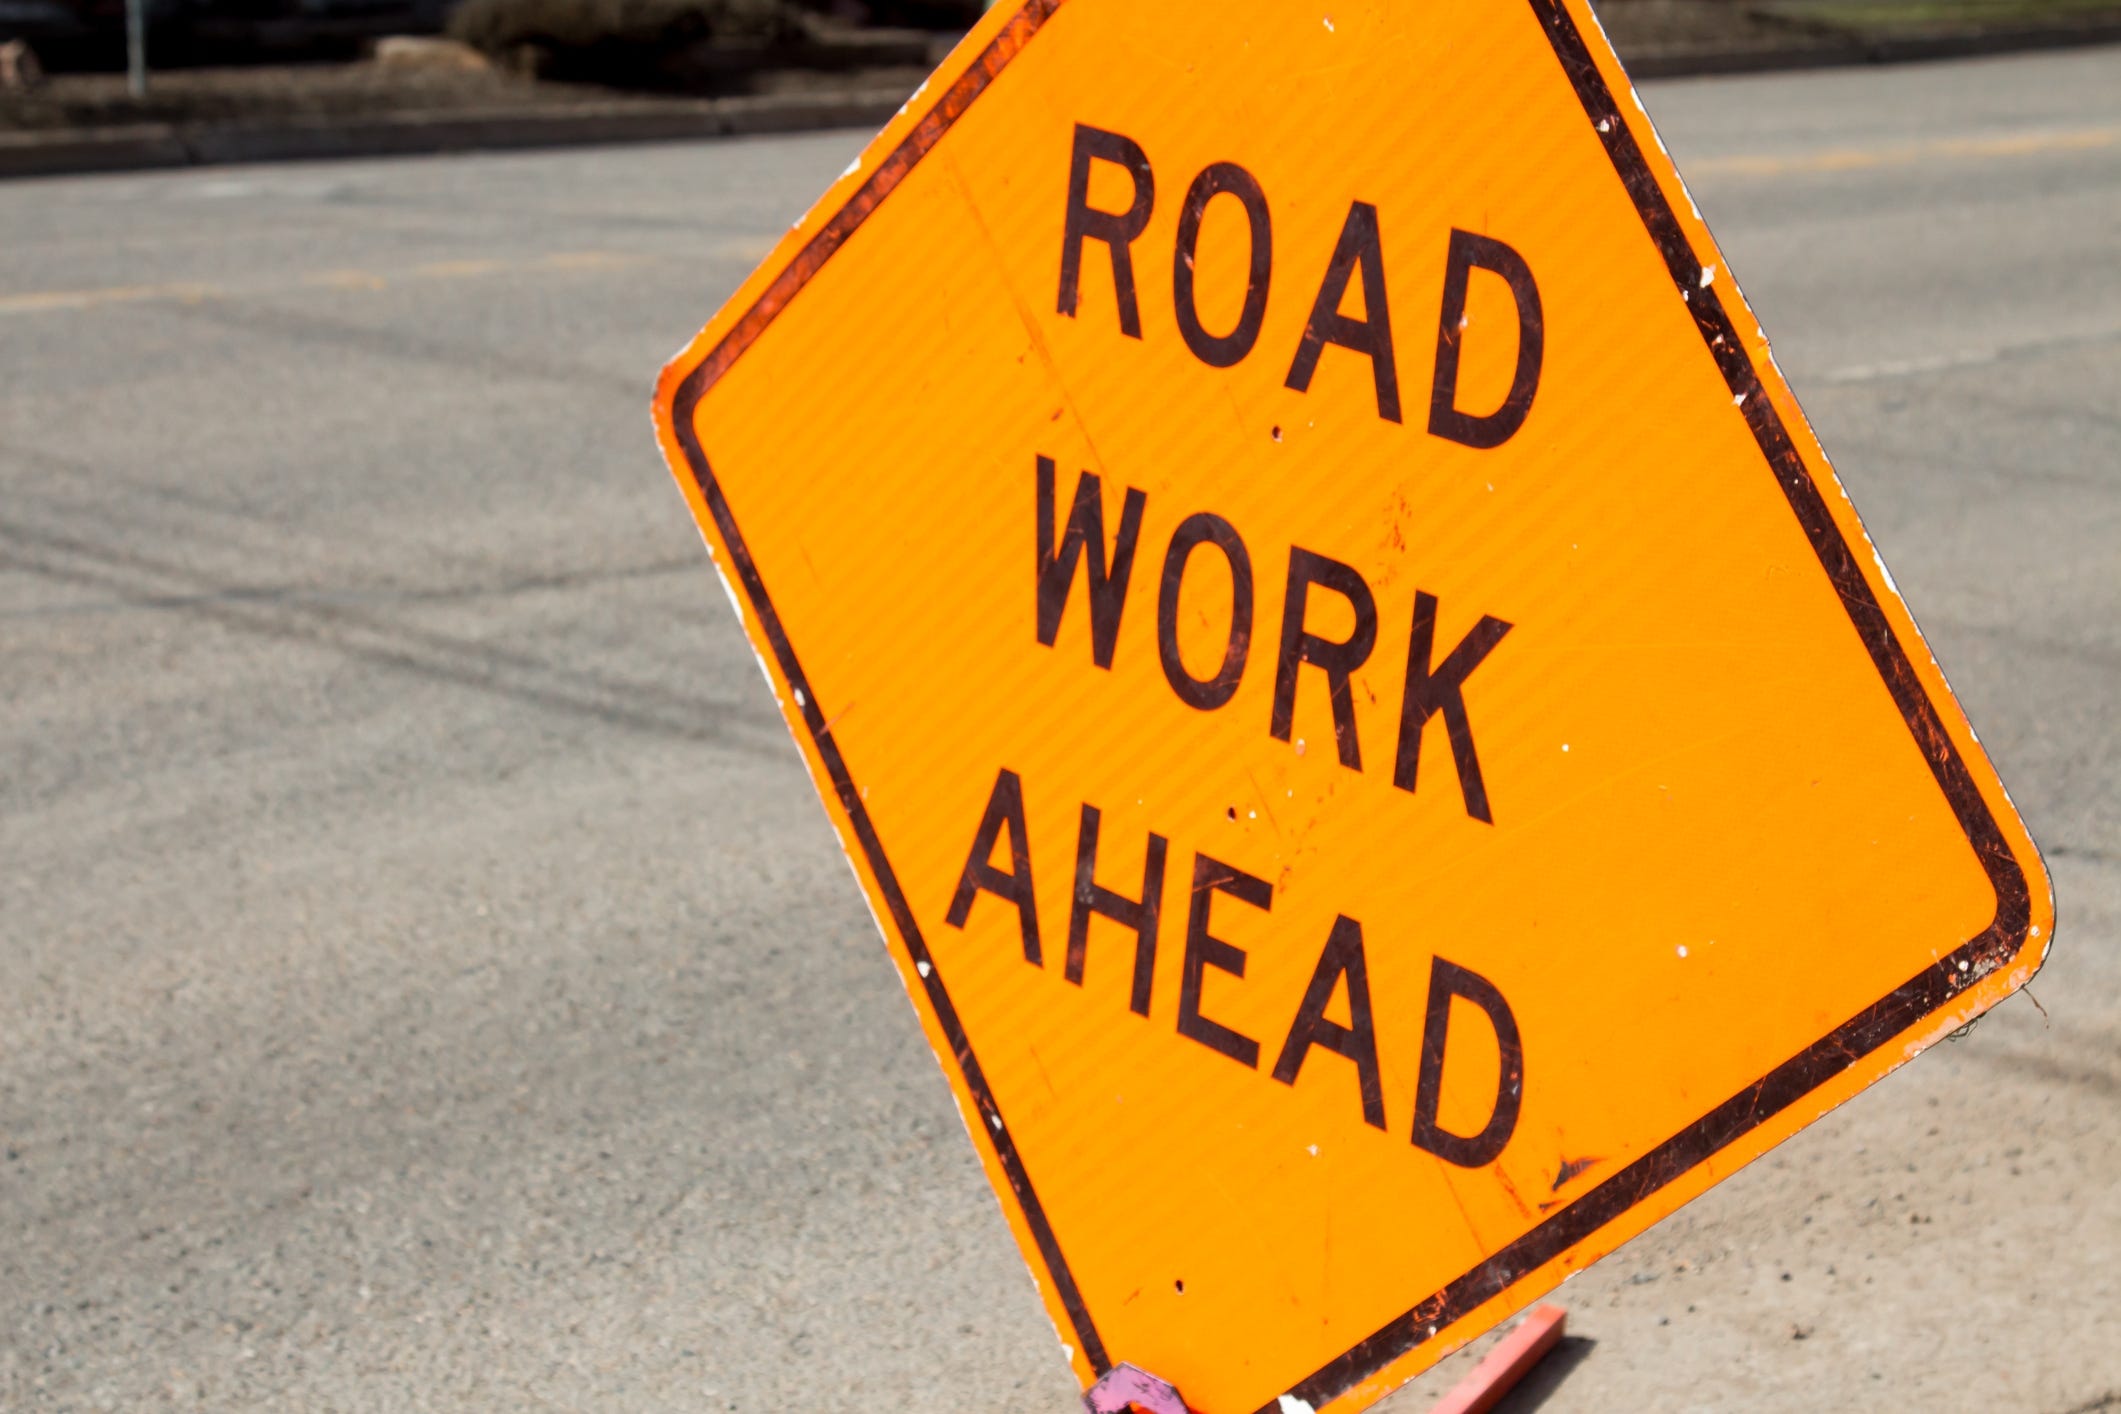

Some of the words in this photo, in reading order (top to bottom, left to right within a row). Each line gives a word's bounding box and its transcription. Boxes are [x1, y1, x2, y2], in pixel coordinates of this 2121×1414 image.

[1057, 122, 1543, 449] ROAD
[1036, 454, 1512, 824] WORK
[944, 767, 1523, 1168] AHEAD
